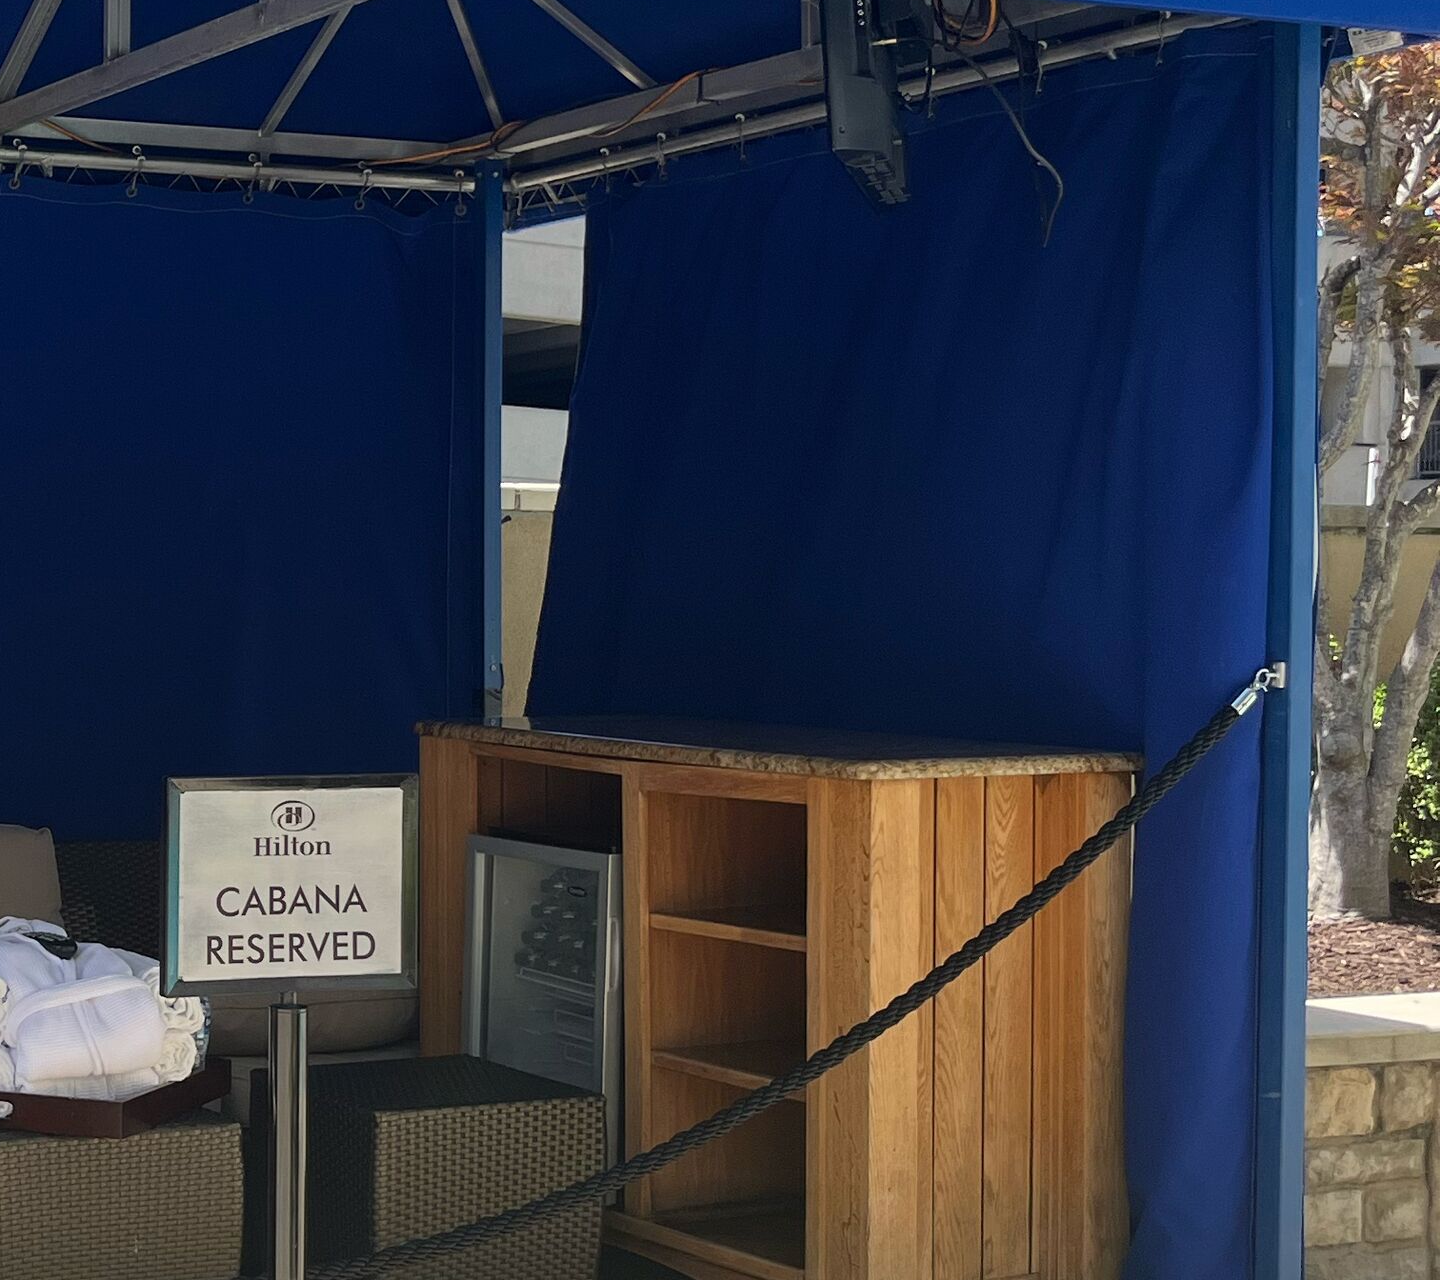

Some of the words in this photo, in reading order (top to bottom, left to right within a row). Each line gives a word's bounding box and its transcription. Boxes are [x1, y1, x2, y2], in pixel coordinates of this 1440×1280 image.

[253, 834, 331, 856] Hilton
[216, 883, 368, 917] CABANA
[206, 931, 376, 965] RESERVED
